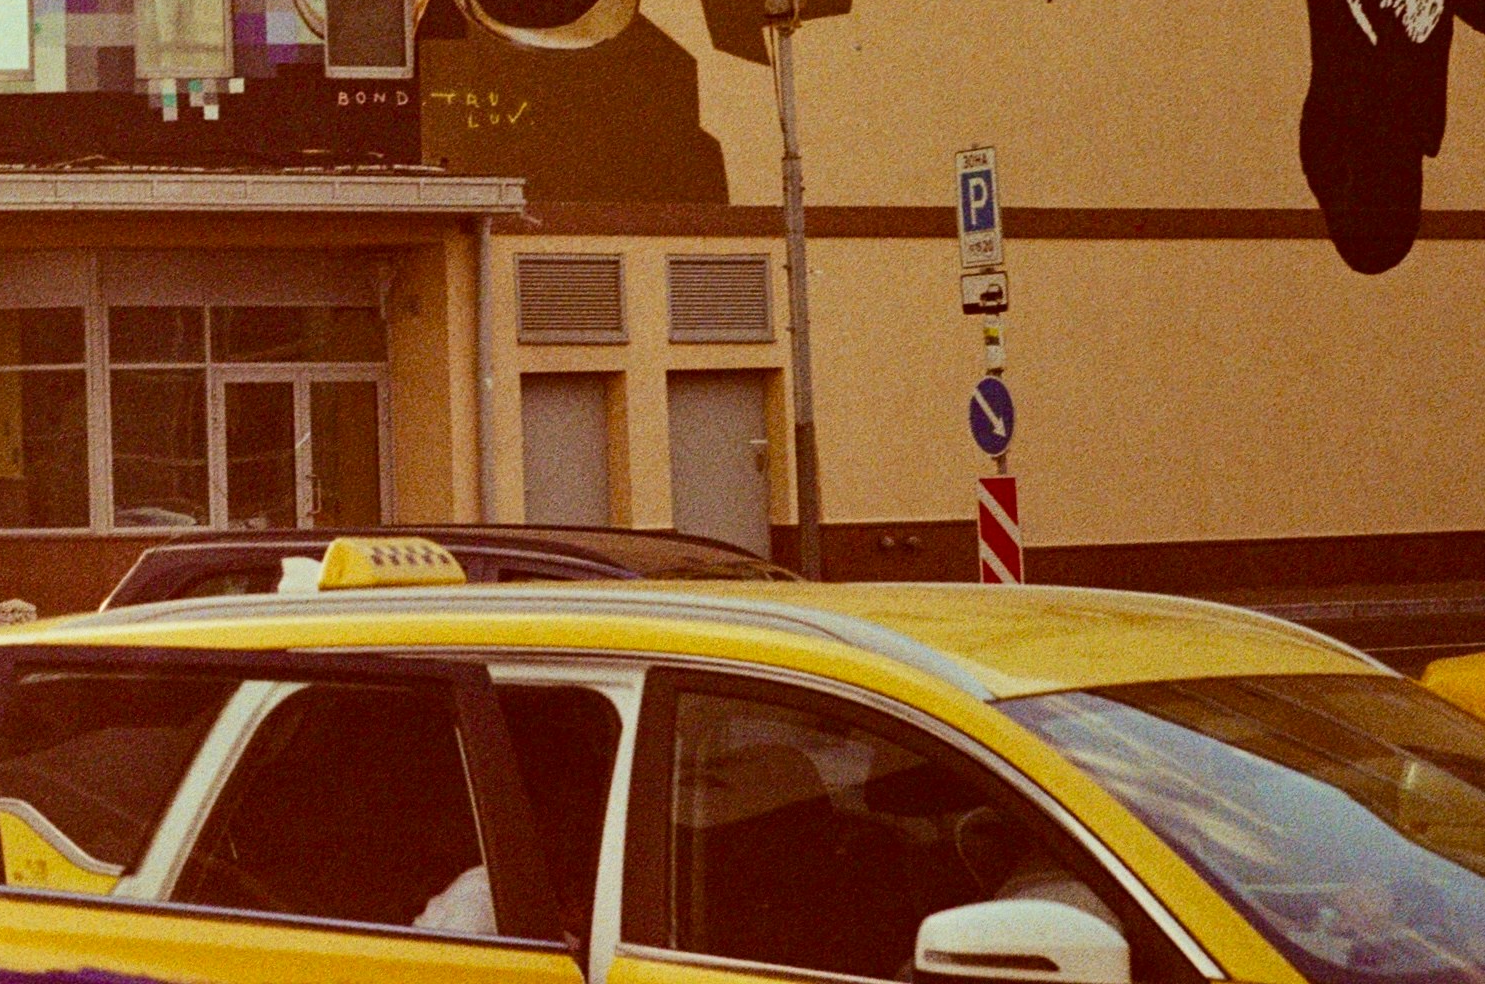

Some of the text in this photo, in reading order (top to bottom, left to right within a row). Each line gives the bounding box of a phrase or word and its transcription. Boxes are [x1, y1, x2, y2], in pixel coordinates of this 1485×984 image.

[337, 90, 409, 106] BOND
[963, 153, 988, 169] ЗОНА
[968, 176, 988, 226] P
